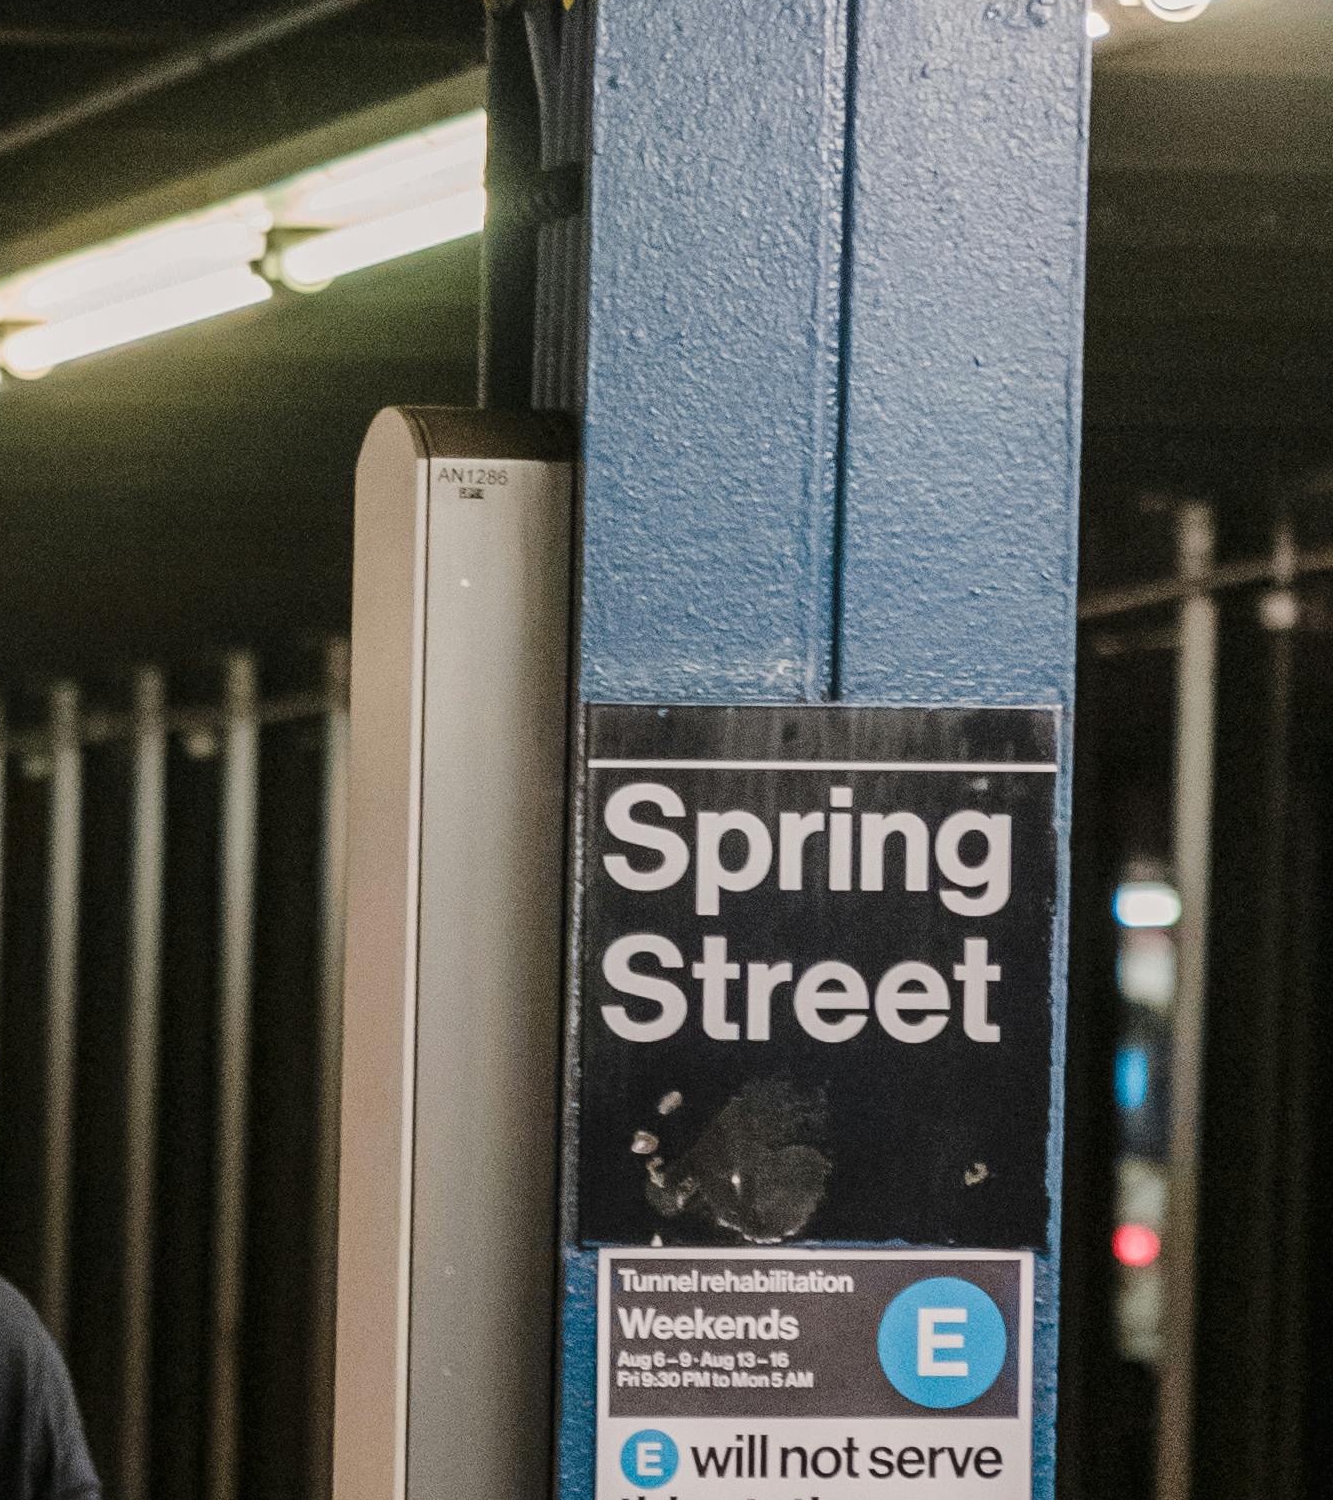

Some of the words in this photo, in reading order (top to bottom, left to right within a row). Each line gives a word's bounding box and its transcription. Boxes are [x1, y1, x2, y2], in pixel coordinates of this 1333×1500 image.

[601, 782, 1013, 917] Spring
[600, 933, 1002, 1044] Street
[618, 1269, 698, 1292] Tunnel
[701, 1269, 854, 1293] rehabilitation
[618, 1307, 800, 1340] Weekends
[917, 1308, 969, 1377] E
[618, 1351, 652, 1370] Aug
[700, 1351, 734, 1370] Aug
[712, 1372, 731, 1387] to
[733, 1372, 770, 1388] Mon
[771, 1372, 783, 1388] 5
[785, 1372, 815, 1388] AM
[636, 1442, 664, 1477] E
[691, 1434, 769, 1479] will
[780, 1437, 861, 1479] not
[868, 1445, 1004, 1480] serve
